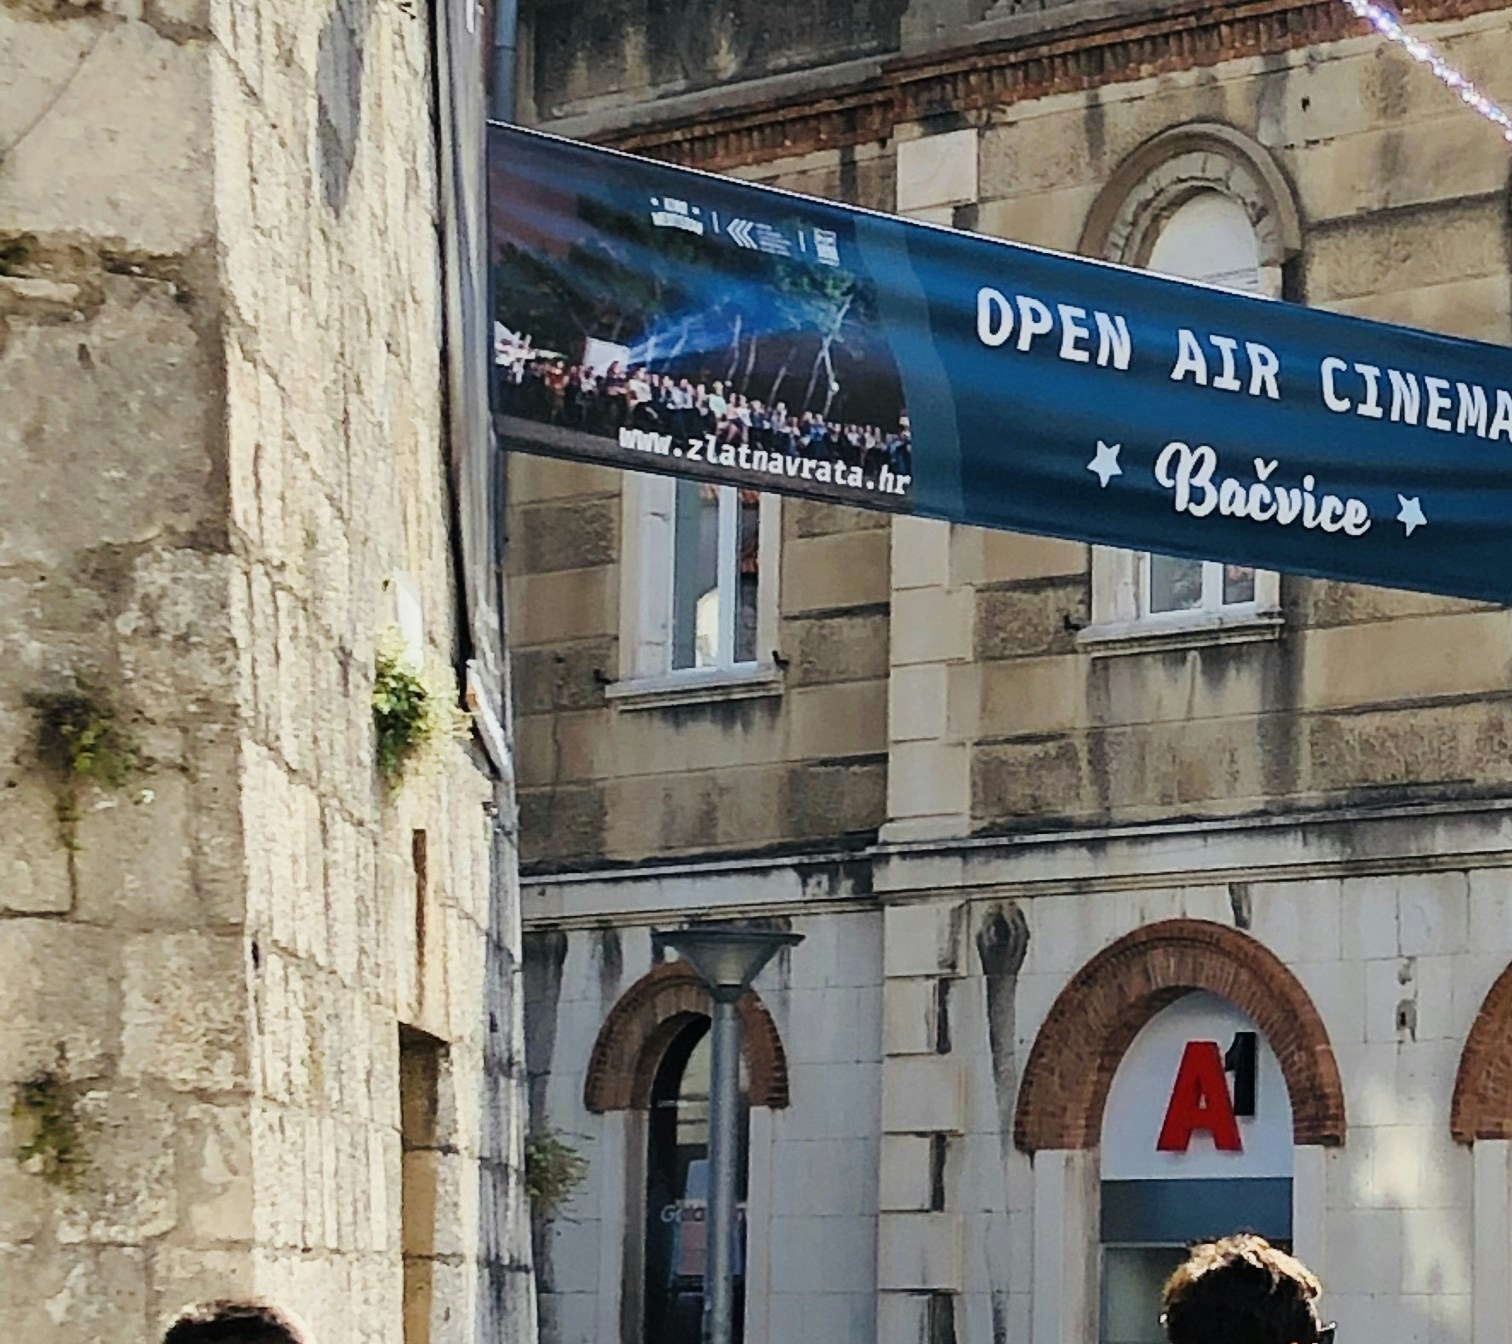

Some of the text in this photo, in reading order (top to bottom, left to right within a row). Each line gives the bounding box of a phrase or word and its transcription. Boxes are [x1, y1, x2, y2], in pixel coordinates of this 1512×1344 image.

[977, 287, 1132, 370] OPEN
[1170, 329, 1280, 400] AIR
[618, 426, 912, 495] www.zlatnavrata.hr
[1154, 441, 1371, 536] Bačvice
[1156, 1031, 1257, 1153] A1
